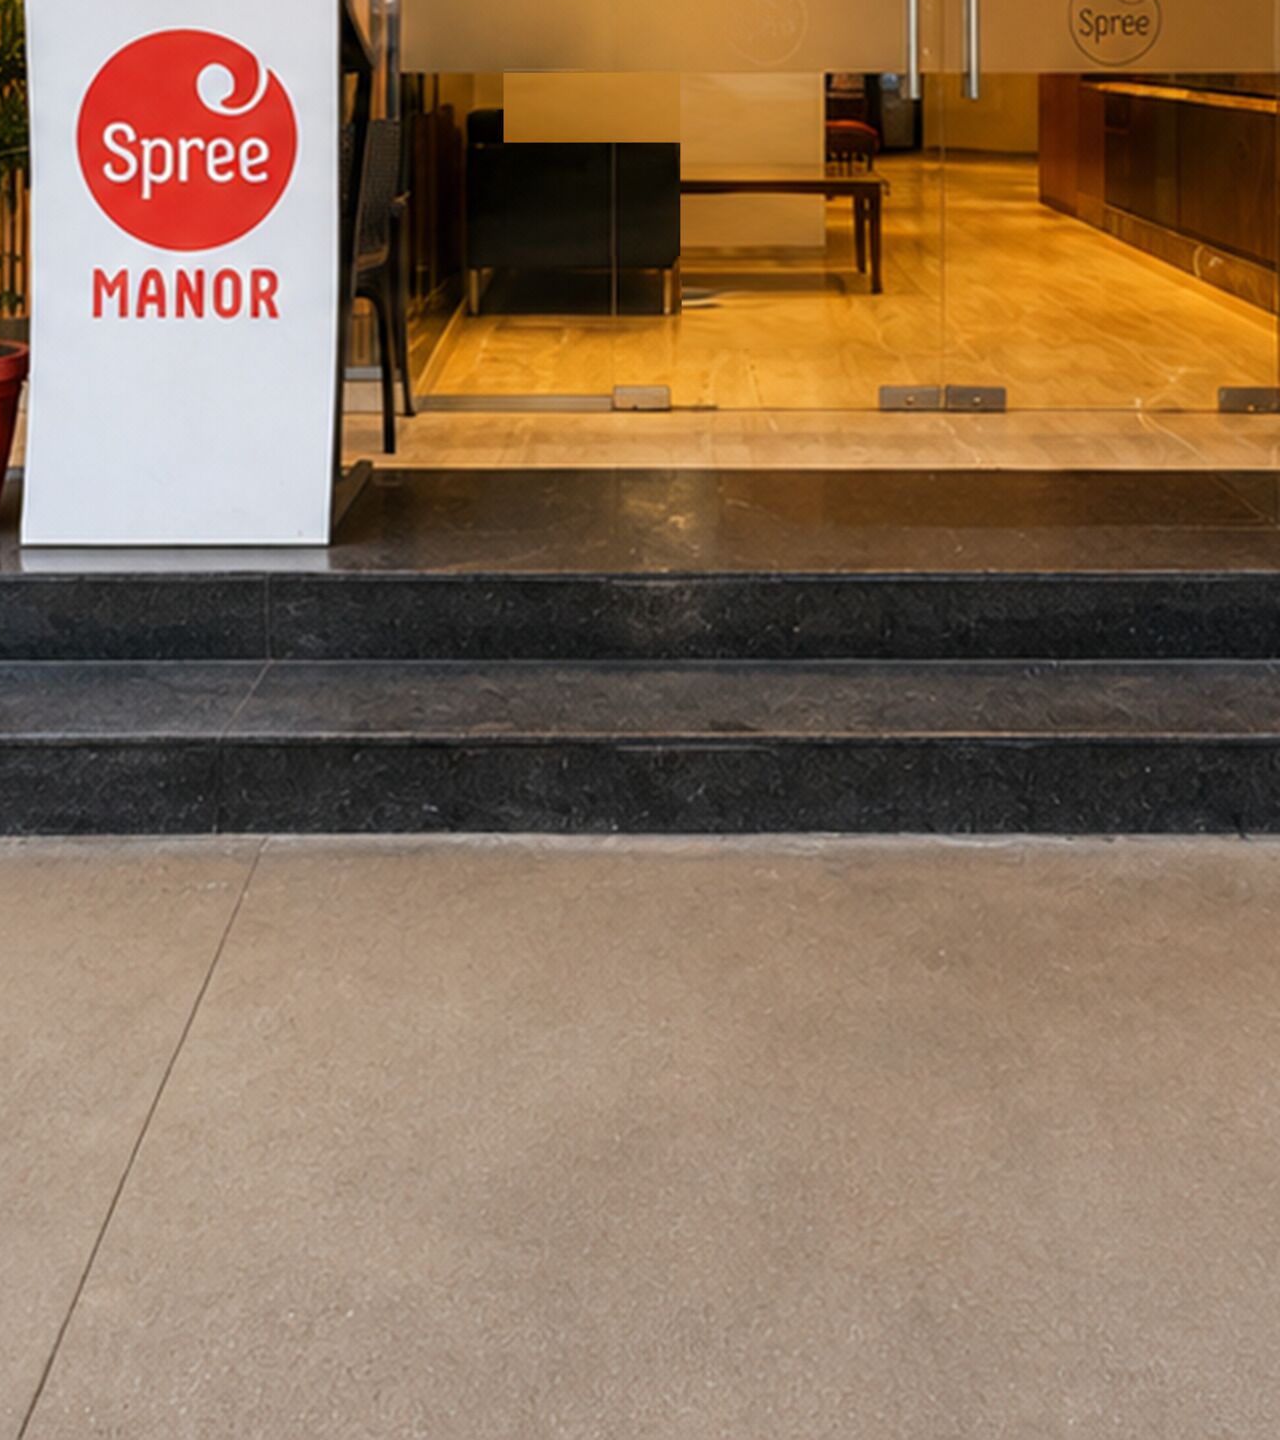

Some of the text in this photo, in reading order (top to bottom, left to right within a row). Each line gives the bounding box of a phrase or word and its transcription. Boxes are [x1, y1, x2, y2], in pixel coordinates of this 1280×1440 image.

[1079, 7, 1150, 44] Spree
[102, 121, 270, 200] Spree
[92, 267, 280, 319] MANOR
